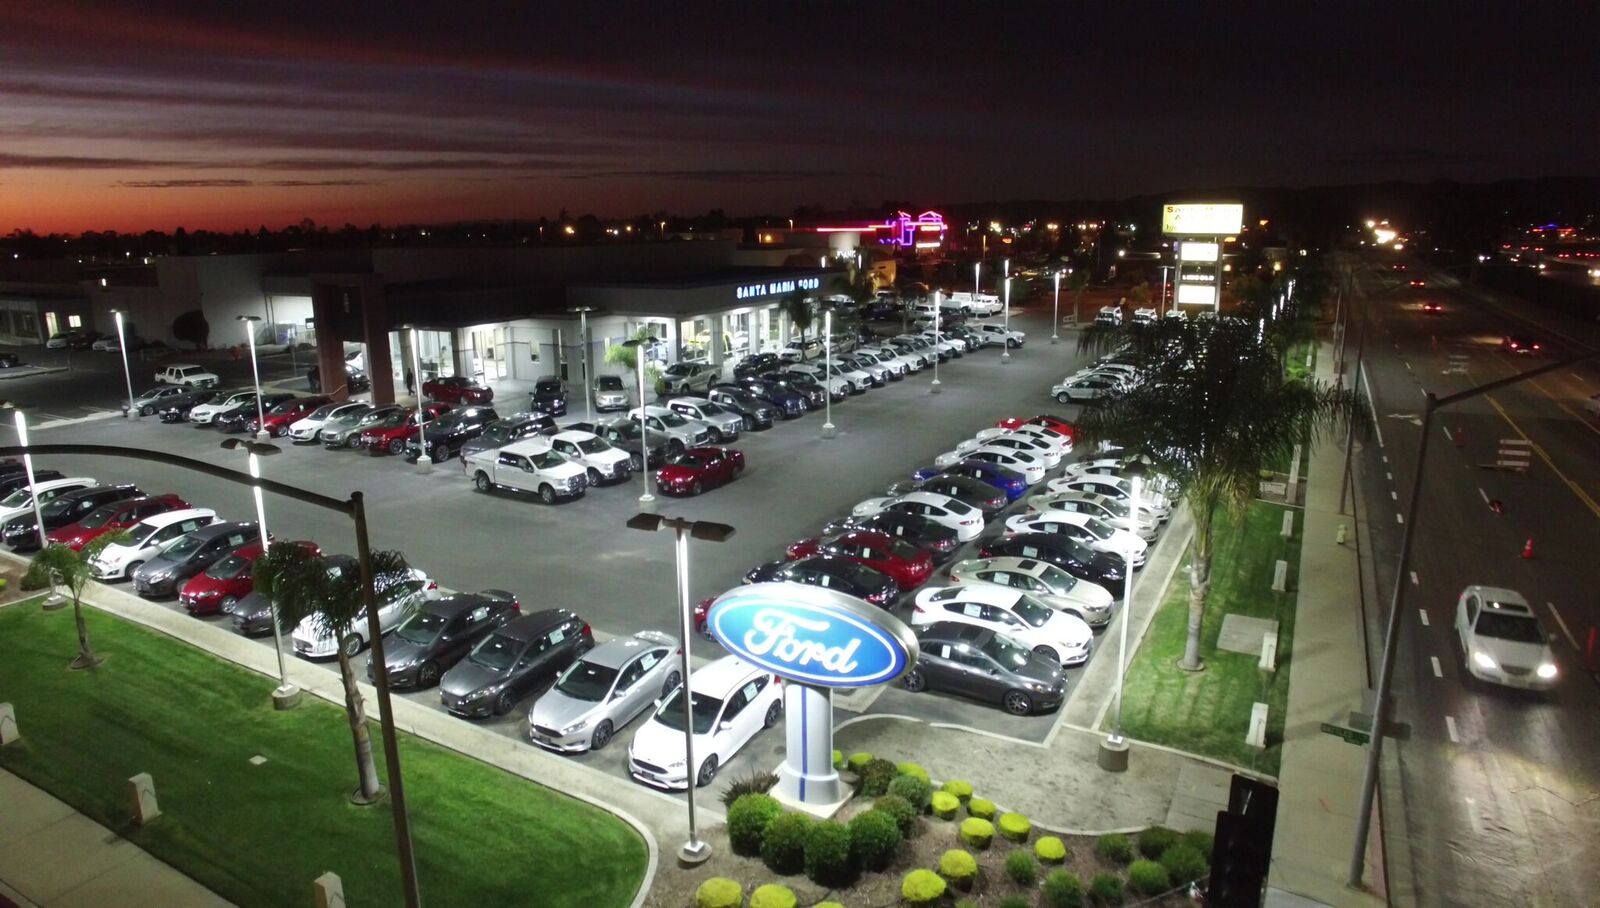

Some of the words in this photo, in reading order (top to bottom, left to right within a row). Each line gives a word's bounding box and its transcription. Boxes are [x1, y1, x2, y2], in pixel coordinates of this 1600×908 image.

[736, 284, 767, 299] SANTA
[769, 281, 795, 294] MARIA
[798, 278, 819, 290] FORD
[743, 607, 861, 674] Ford
